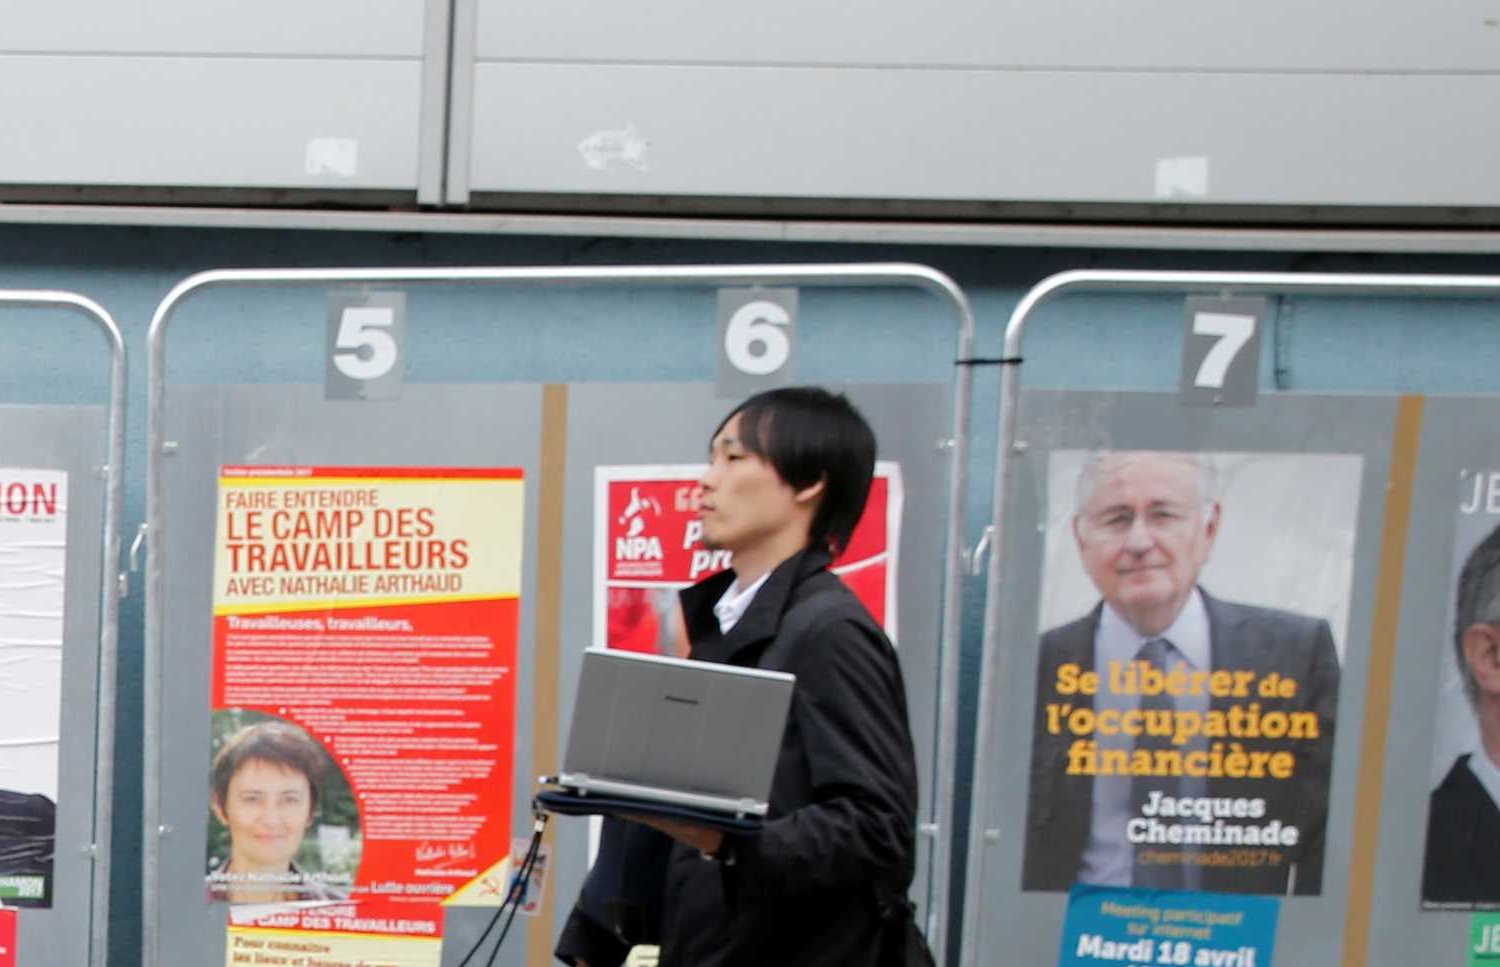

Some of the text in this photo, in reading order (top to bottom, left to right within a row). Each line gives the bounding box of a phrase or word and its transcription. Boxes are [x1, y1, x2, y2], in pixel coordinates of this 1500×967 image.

[334, 308, 398, 379] 5
[724, 301, 790, 375] 6
[1192, 311, 1255, 388] 7
[226, 490, 379, 509] FAIRE ENTENDRE
[227, 508, 434, 540] LE CAMP DES
[226, 539, 469, 573] TRAVAILLEURS
[616, 536, 663, 560] NPA
[226, 573, 462, 596] AVEC NATHALIE ARTHAUD
[1055, 660, 1297, 698] Se libérer de
[1046, 703, 1319, 744] l'occupation
[1066, 740, 1295, 778] financière
[1141, 791, 1266, 821] Jacques
[1126, 818, 1299, 845] Cheminade
[335, 917, 436, 933] TRAVAILLEURS
[233, 936, 264, 949] Pour
[1076, 933, 1154, 963] Mardi
[1157, 940, 1192, 965] 18
[233, 952, 252, 964] les
[255, 952, 287, 966] lieux
[292, 955, 306, 967] et
